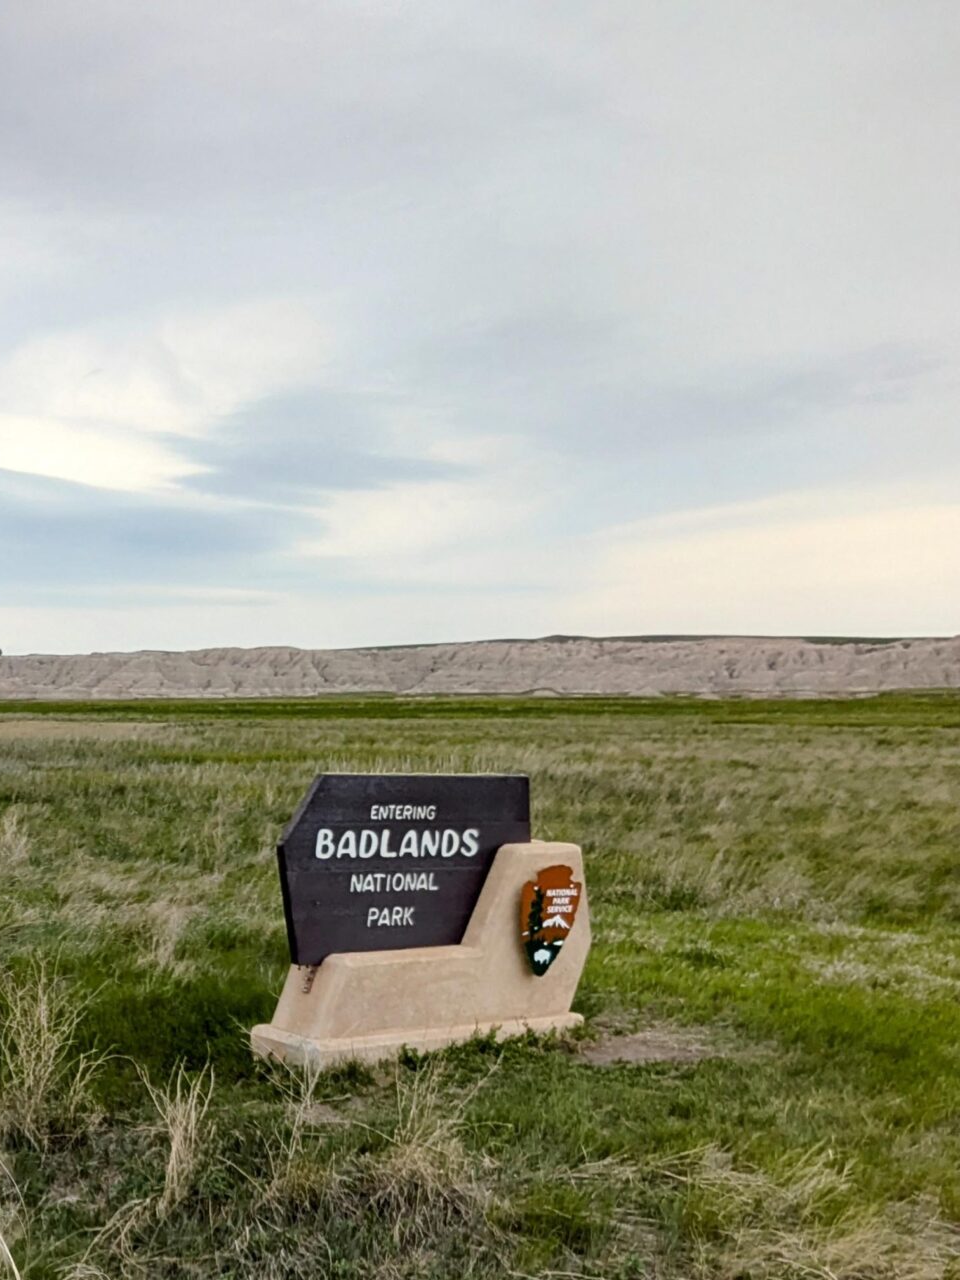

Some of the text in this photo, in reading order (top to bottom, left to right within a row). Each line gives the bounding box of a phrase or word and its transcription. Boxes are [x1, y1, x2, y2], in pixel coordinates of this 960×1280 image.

[370, 805, 437, 821] ENTERING
[315, 828, 480, 859] BADLANDS
[350, 873, 439, 893] NATIONAL
[546, 888, 578, 897] NATIONAL
[552, 897, 570, 905] PARK
[367, 906, 415, 928] PARK
[546, 905, 573, 914] SERVICE
